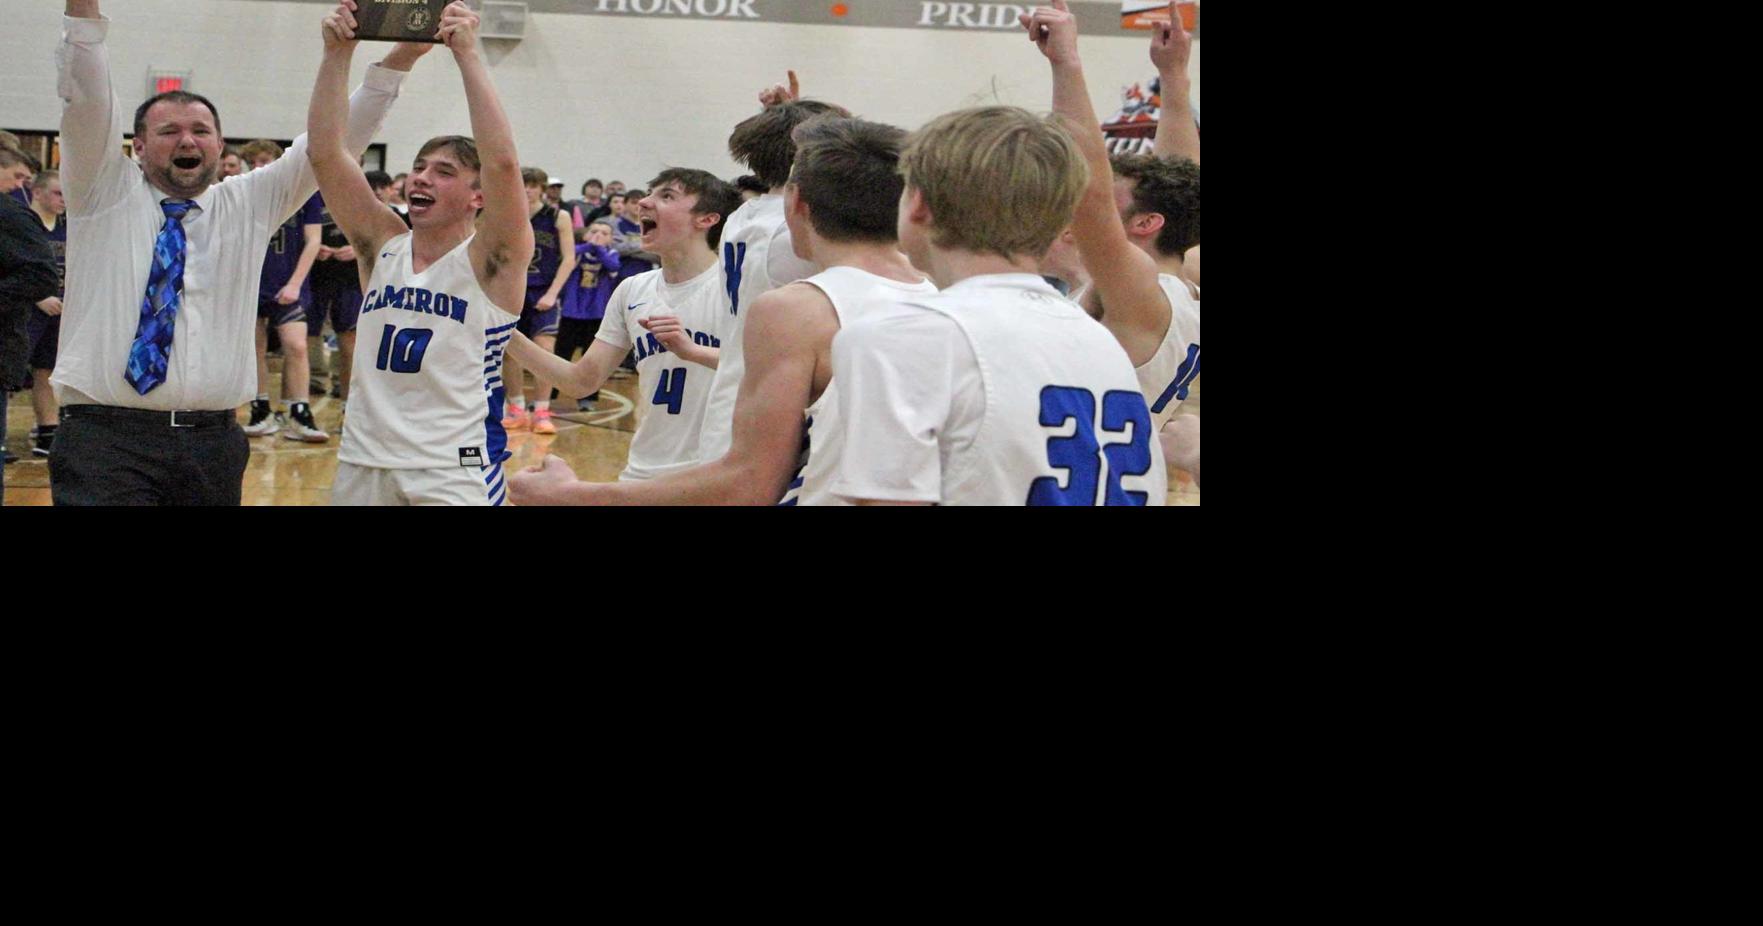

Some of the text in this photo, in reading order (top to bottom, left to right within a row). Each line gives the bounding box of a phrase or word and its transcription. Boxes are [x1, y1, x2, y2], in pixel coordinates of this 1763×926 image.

[918, 1, 1040, 28] PRID
[362, 284, 468, 325] CAMERON
[376, 323, 434, 374] 10
[652, 367, 687, 414] 4
[1026, 385, 1152, 506] 32
